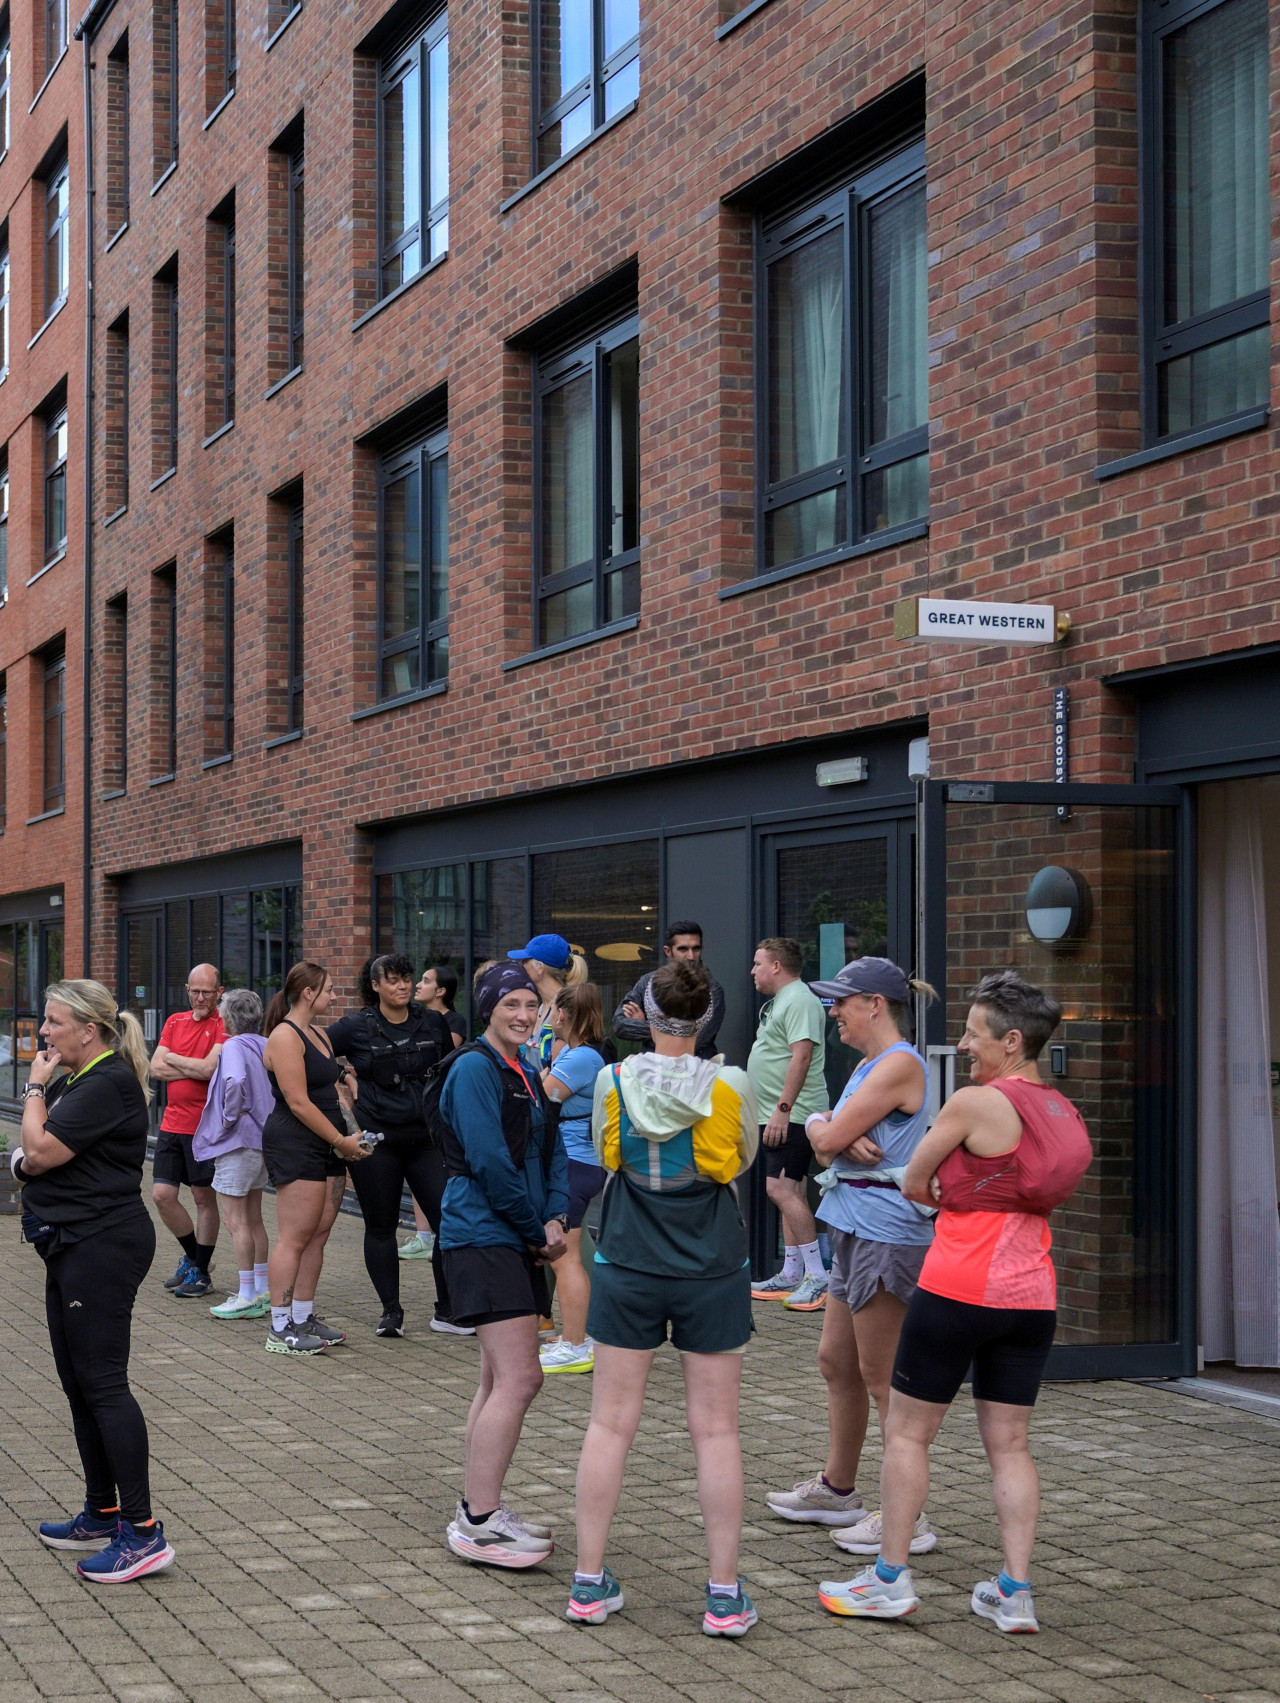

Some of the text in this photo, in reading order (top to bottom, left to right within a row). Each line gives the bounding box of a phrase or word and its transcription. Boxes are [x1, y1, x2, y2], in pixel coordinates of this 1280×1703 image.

[928, 612, 1045, 629] GREAT WESTERN
[1056, 724, 1064, 815] GOODSYD
